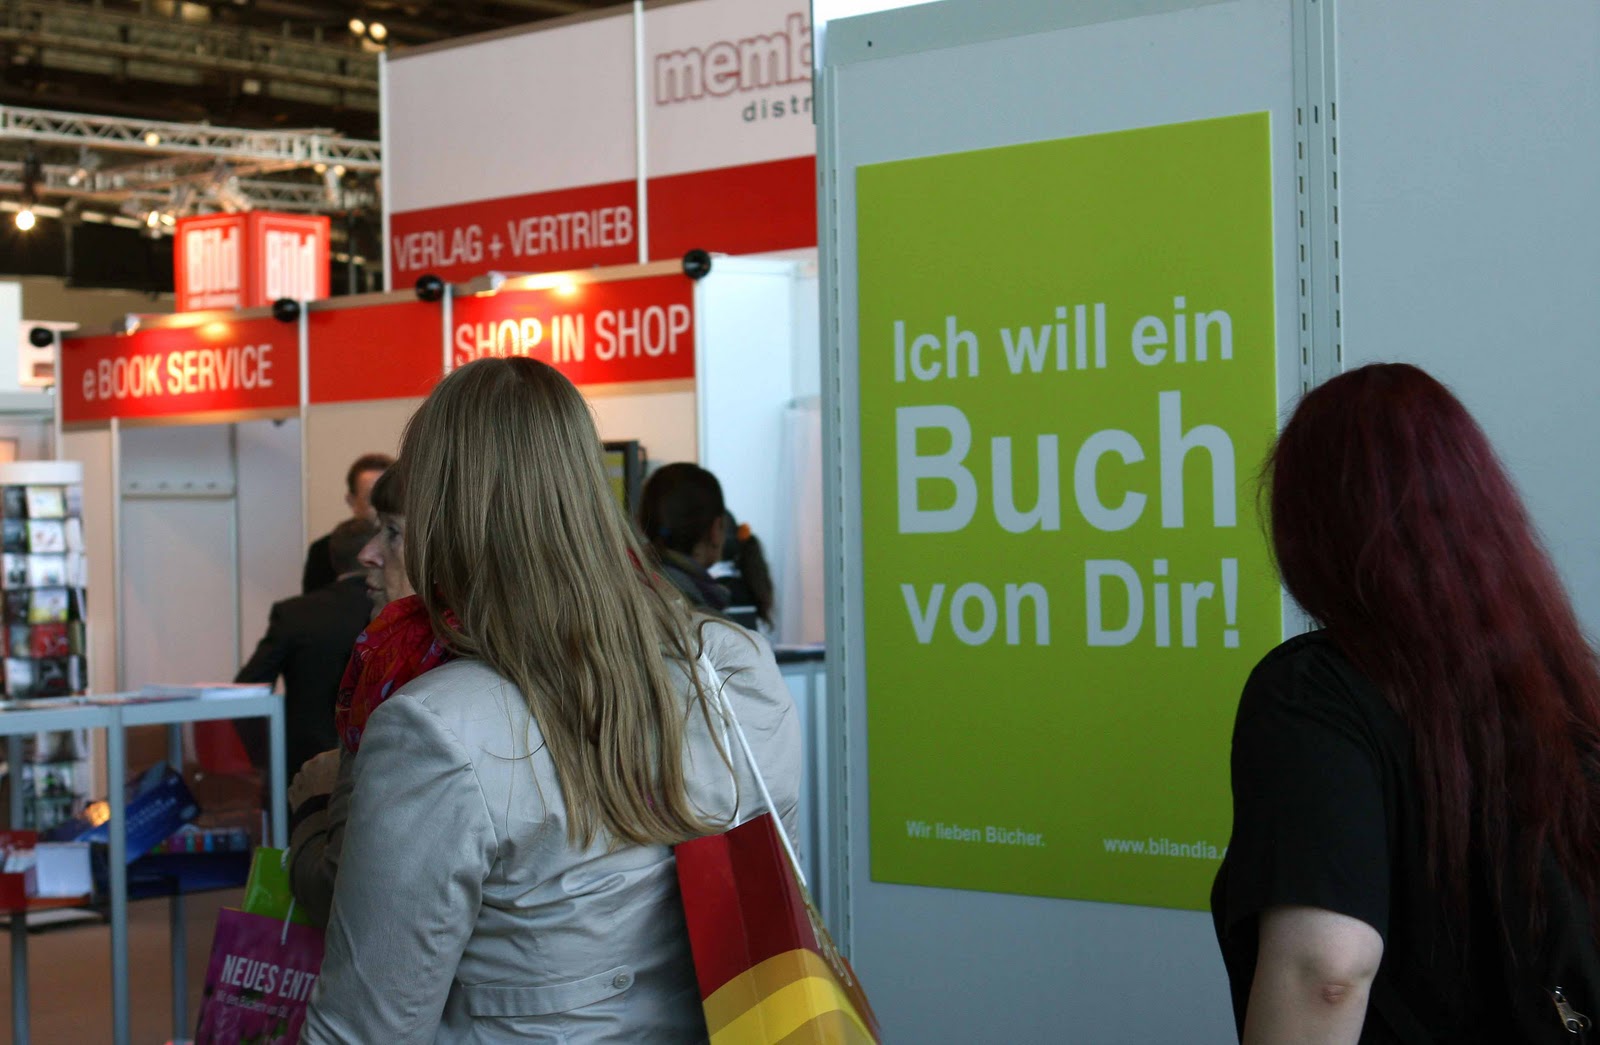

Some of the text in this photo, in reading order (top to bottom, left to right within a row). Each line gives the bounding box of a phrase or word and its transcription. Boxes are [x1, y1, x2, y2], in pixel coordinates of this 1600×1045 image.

[394, 225, 483, 271] VERLAG
[508, 206, 633, 257] VERTRIEB
[456, 304, 691, 367] SHOP IN SHOP
[894, 296, 1234, 382] Ich will ein
[99, 353, 163, 398] BOOK
[166, 344, 273, 395] SERVICE
[896, 390, 1237, 534] Buch
[901, 558, 1240, 648] von Dir!
[906, 820, 1045, 847] Wir lieben Bücher.
[220, 953, 318, 1002] NEUES ENT
